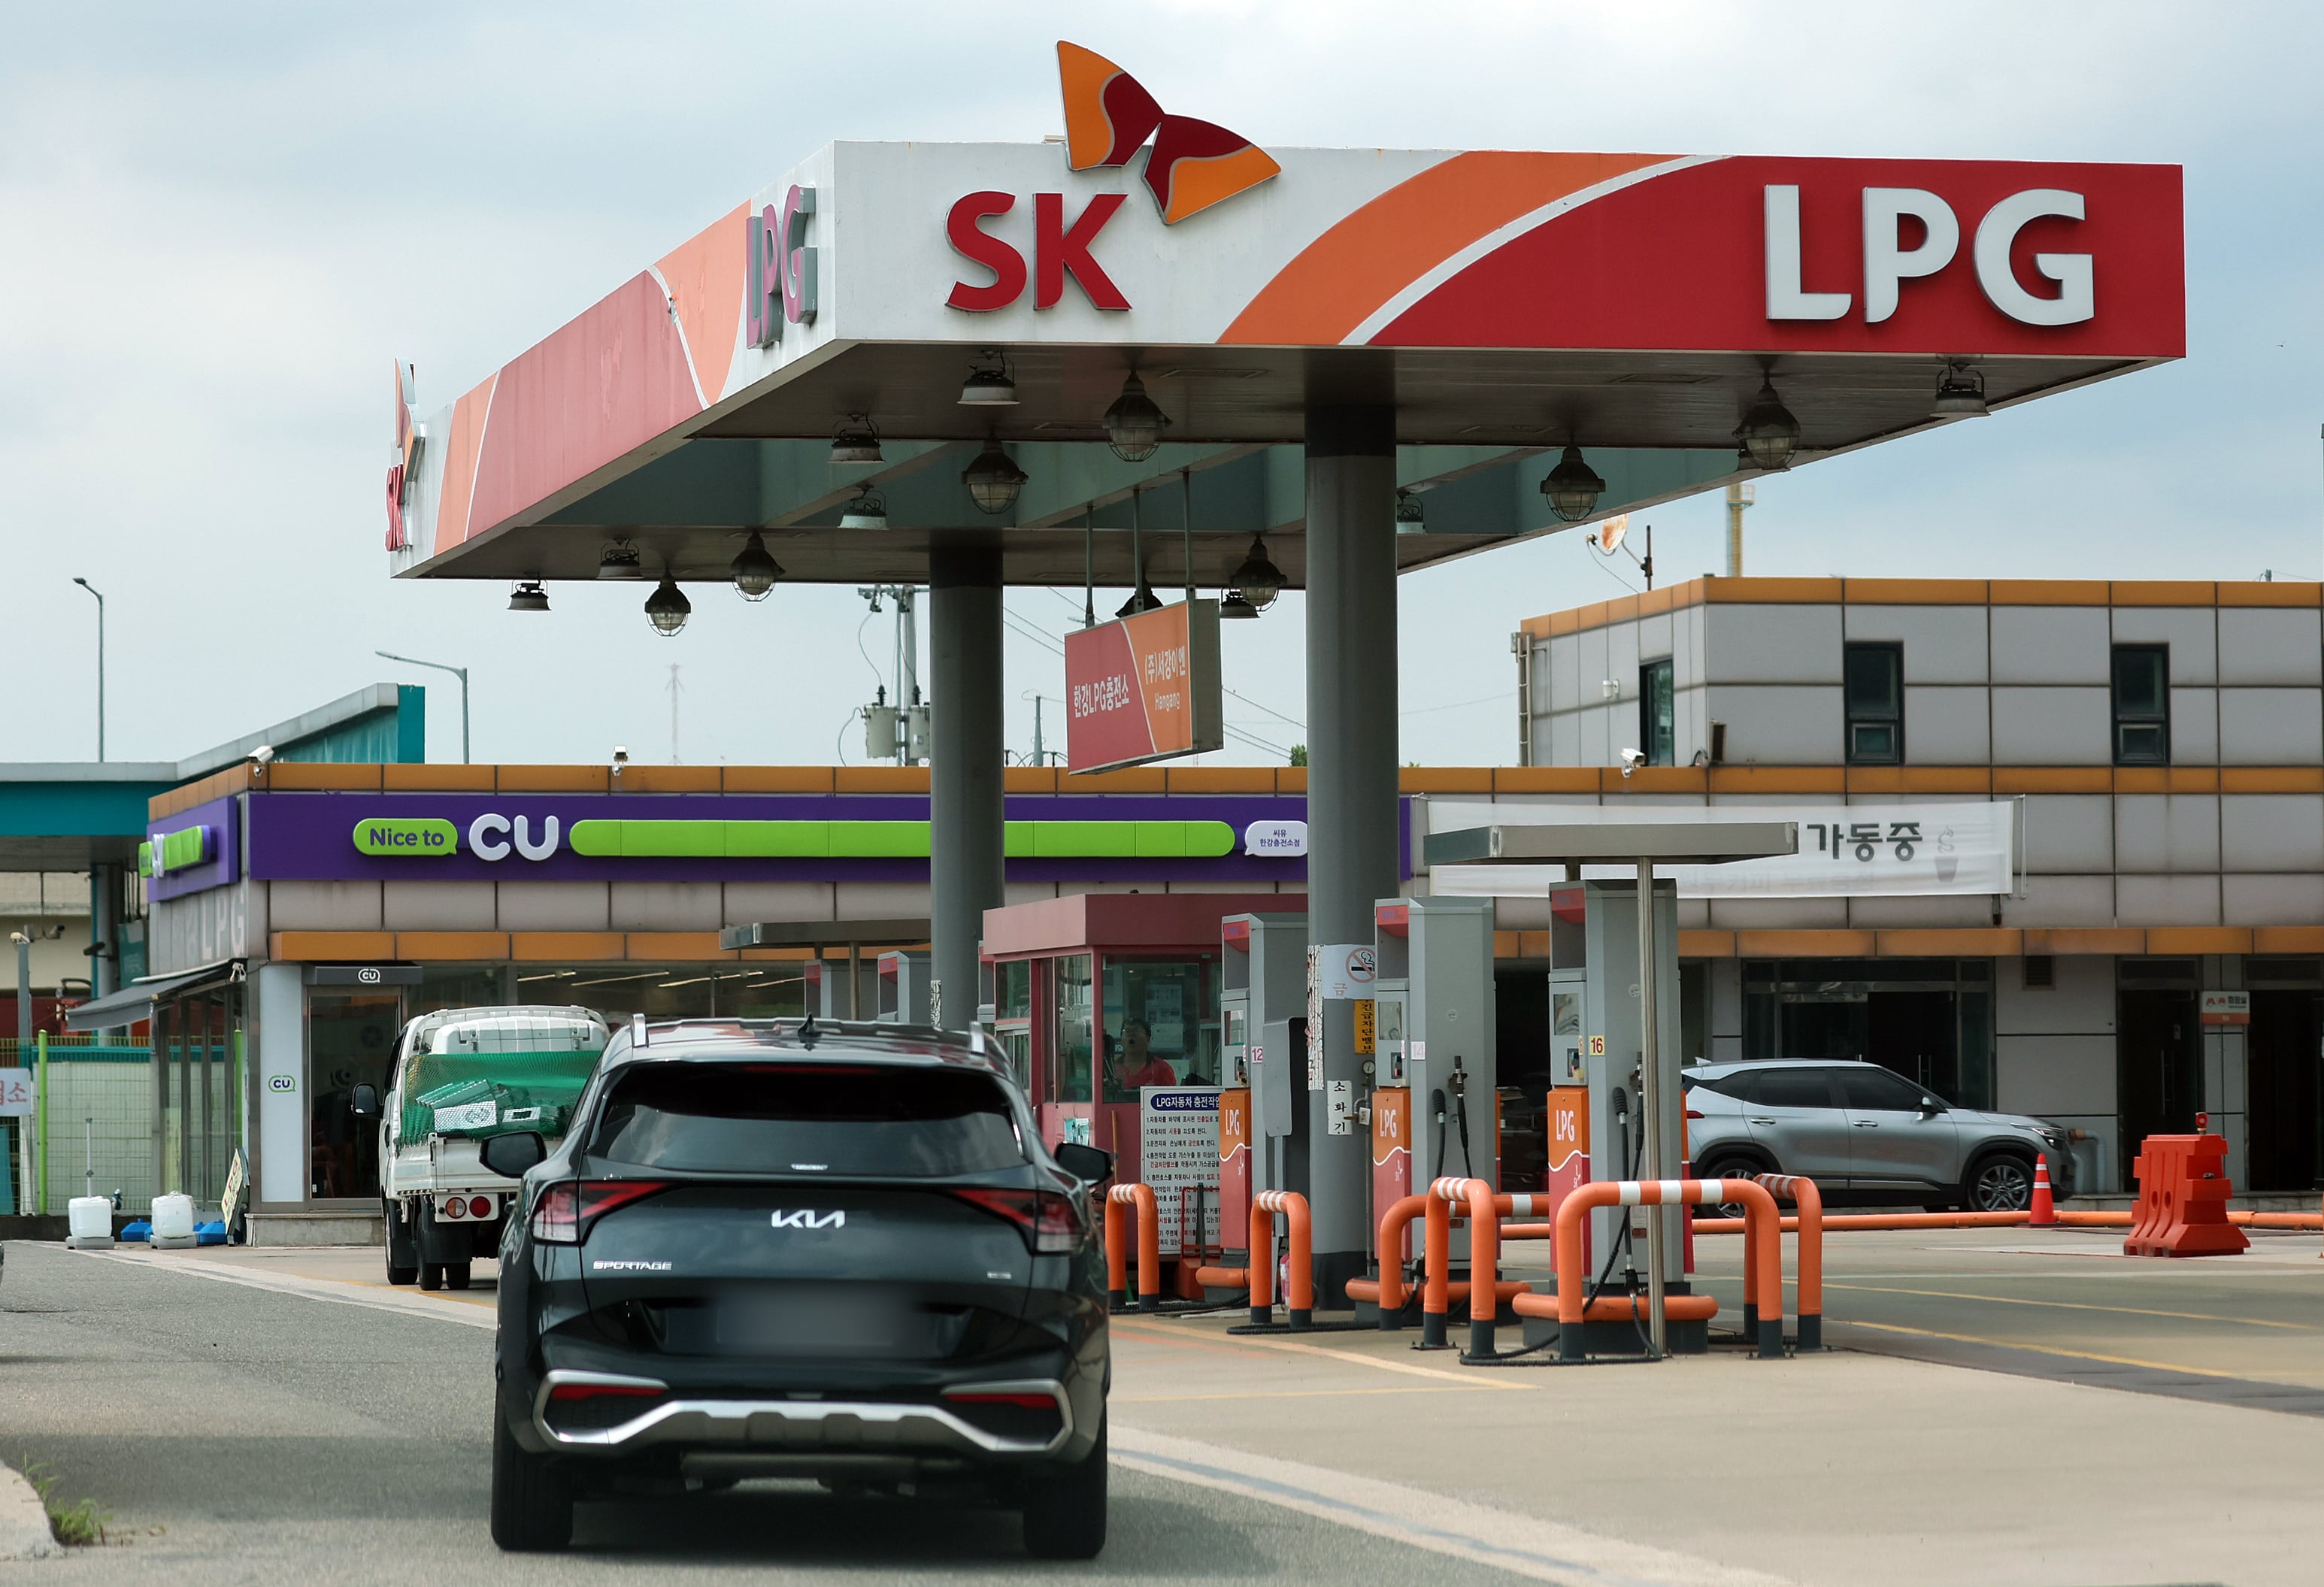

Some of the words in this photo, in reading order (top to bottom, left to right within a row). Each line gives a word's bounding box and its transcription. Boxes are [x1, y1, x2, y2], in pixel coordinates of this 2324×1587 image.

[945, 190, 1132, 312] SK
[1764, 183, 2095, 326] LPG
[746, 184, 817, 349] LPG
[1074, 674, 1130, 718] 한강LPG충전소
[1155, 692, 1180, 712] Hangang
[369, 828, 418, 847] Nice
[422, 829, 445, 847] to
[468, 813, 559, 862] CU
[1260, 838, 1300, 847] 한강충전소점
[1273, 829, 1287, 837] 씨유
[1807, 822, 1923, 862] 가동중
[362, 971, 376, 980] CU
[1333, 983, 1348, 996] 금
[1252, 1048, 1263, 1061] 12
[1590, 1037, 1603, 1053] 16
[274, 1080, 290, 1089] CU
[1156, 1097, 1192, 1107] LPG자동차
[1225, 1109, 1240, 1136] LPG
[1380, 1109, 1397, 1137] LPG
[1556, 1110, 1575, 1142] LPG
[771, 1209, 846, 1228] KIA
[593, 1261, 672, 1271] SPORTAGE
